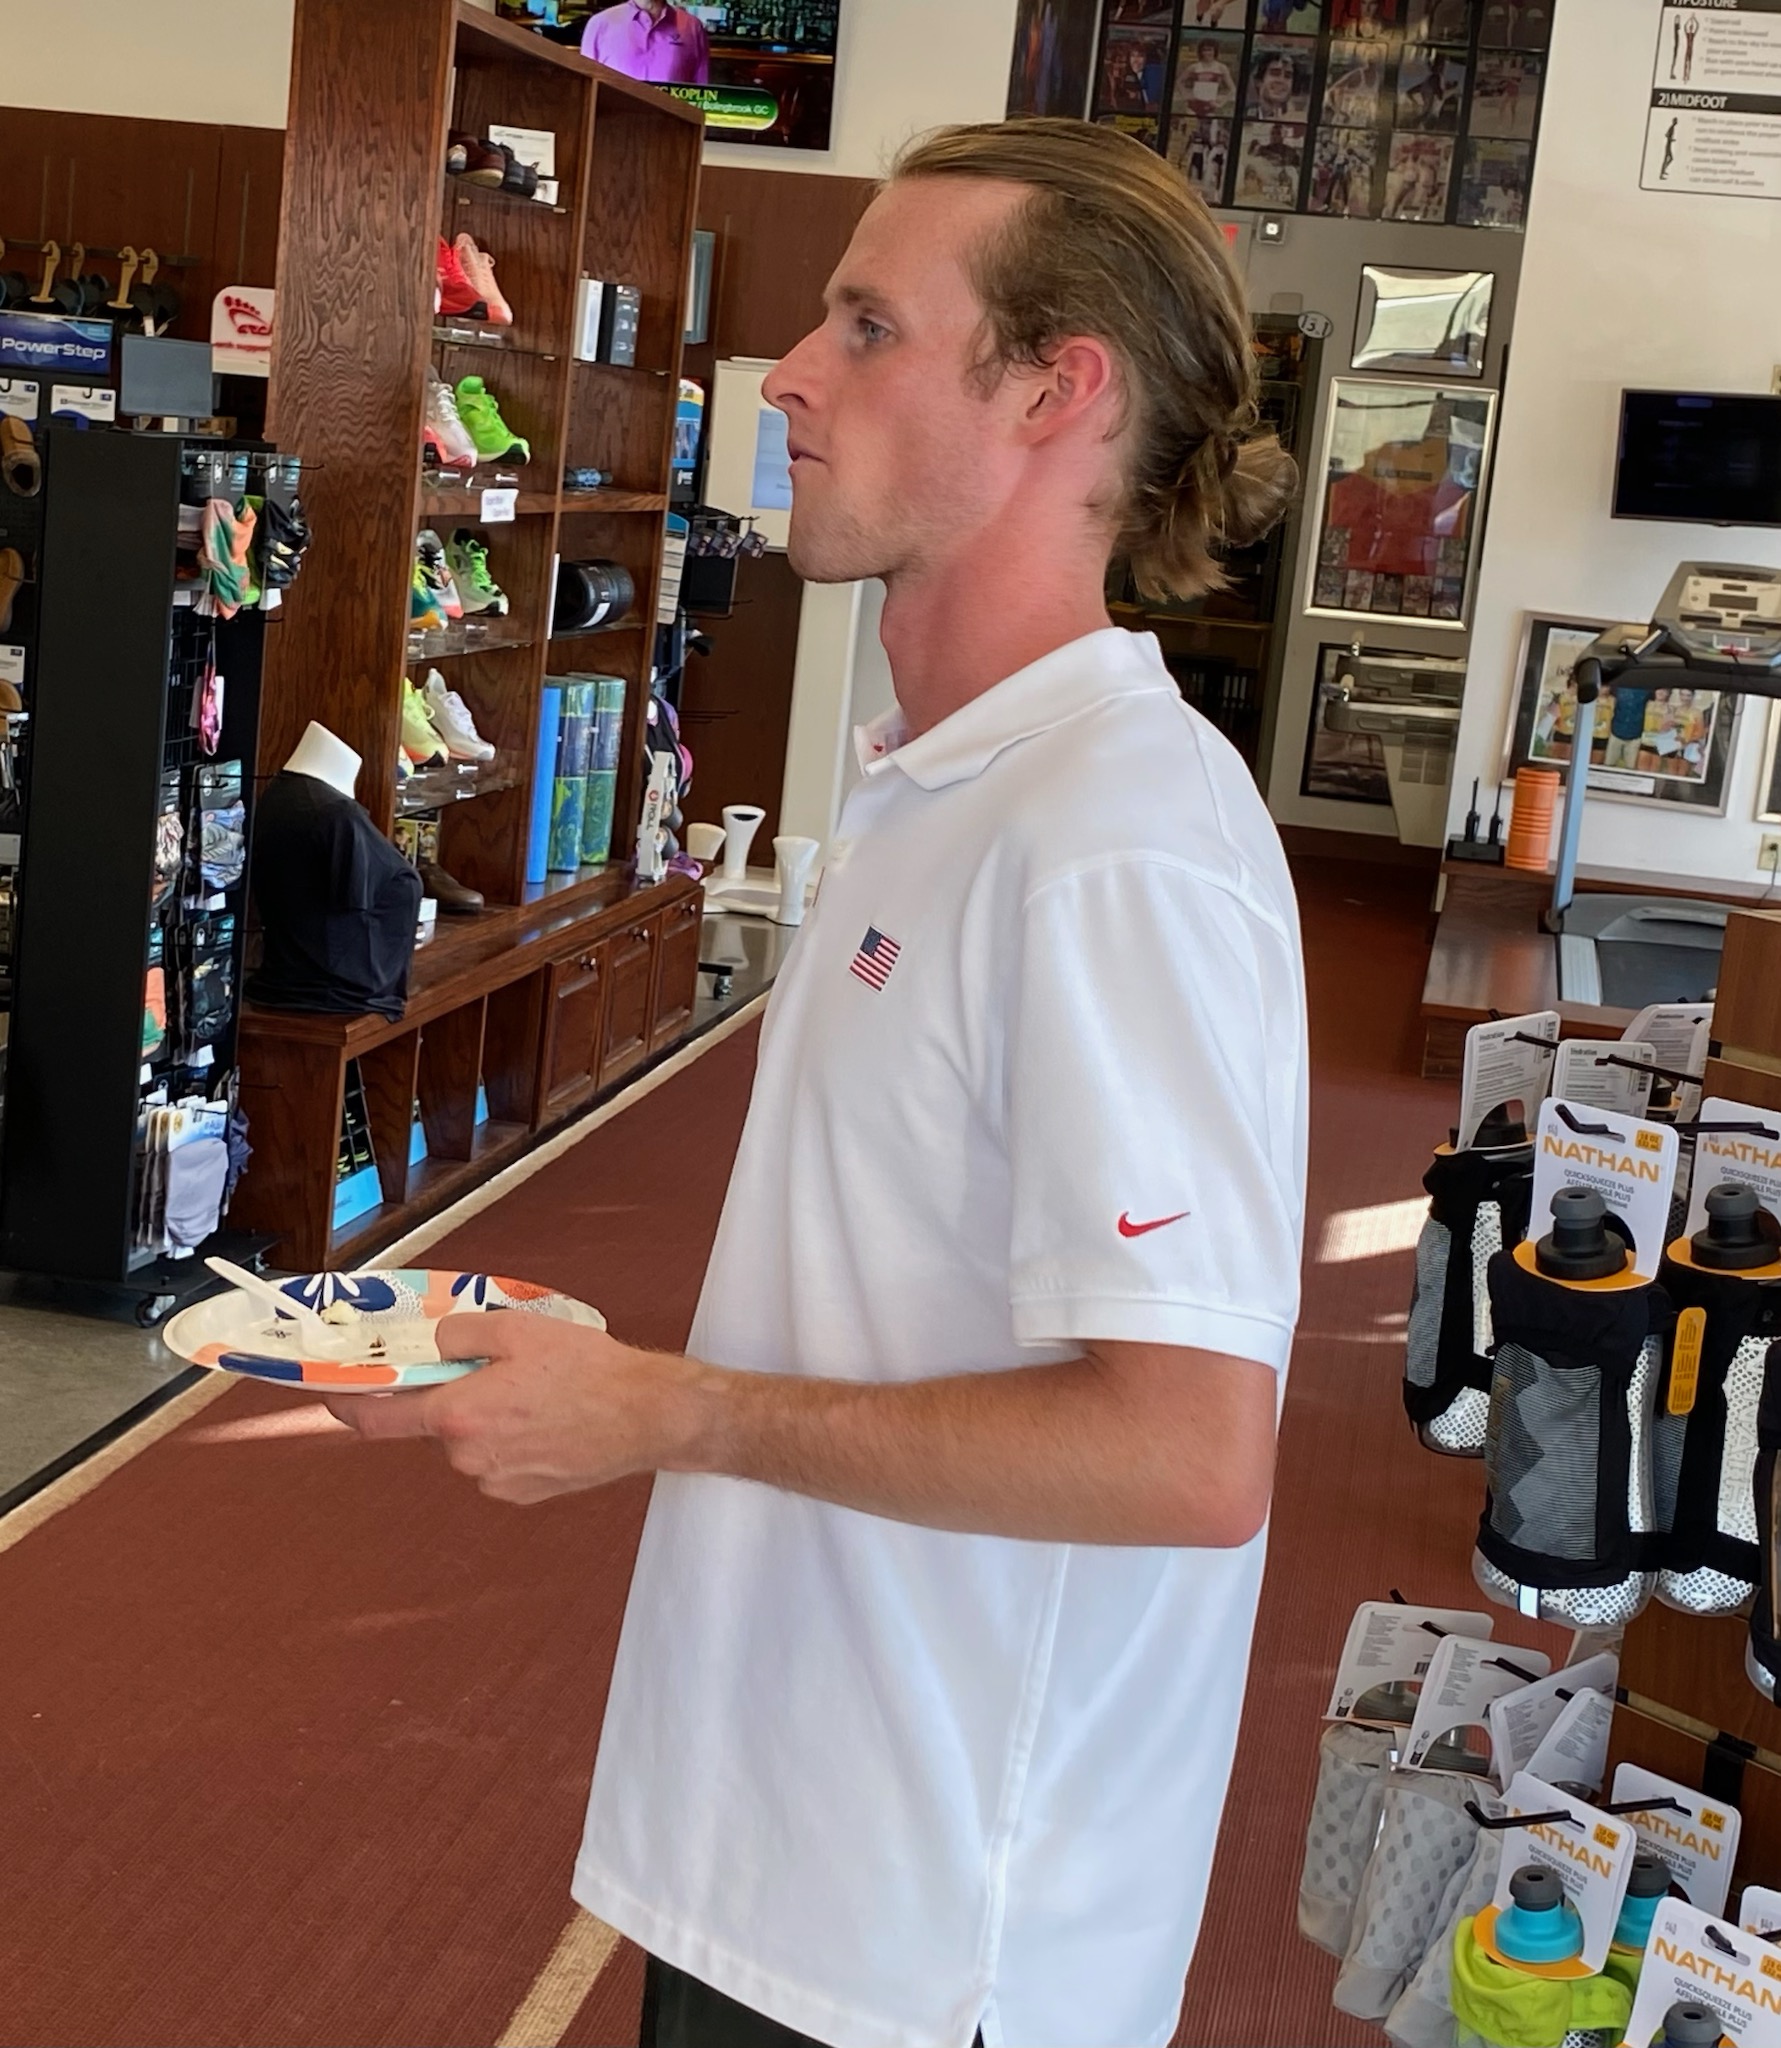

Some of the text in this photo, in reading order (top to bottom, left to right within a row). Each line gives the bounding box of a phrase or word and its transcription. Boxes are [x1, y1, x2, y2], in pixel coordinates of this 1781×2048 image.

[670, 87, 718, 100] KOPLIN
[2, 337, 106, 361] PowerStep
[1543, 1135, 1659, 1183] NATHAN
[1703, 1141, 1781, 1169] NATHA
[1617, 1182, 1634, 1194] PLUS
[1654, 1936, 1781, 2015] NATHAN
[1728, 2013, 1747, 2030] PLUS
[1733, 2005, 1752, 2021] PLUS
